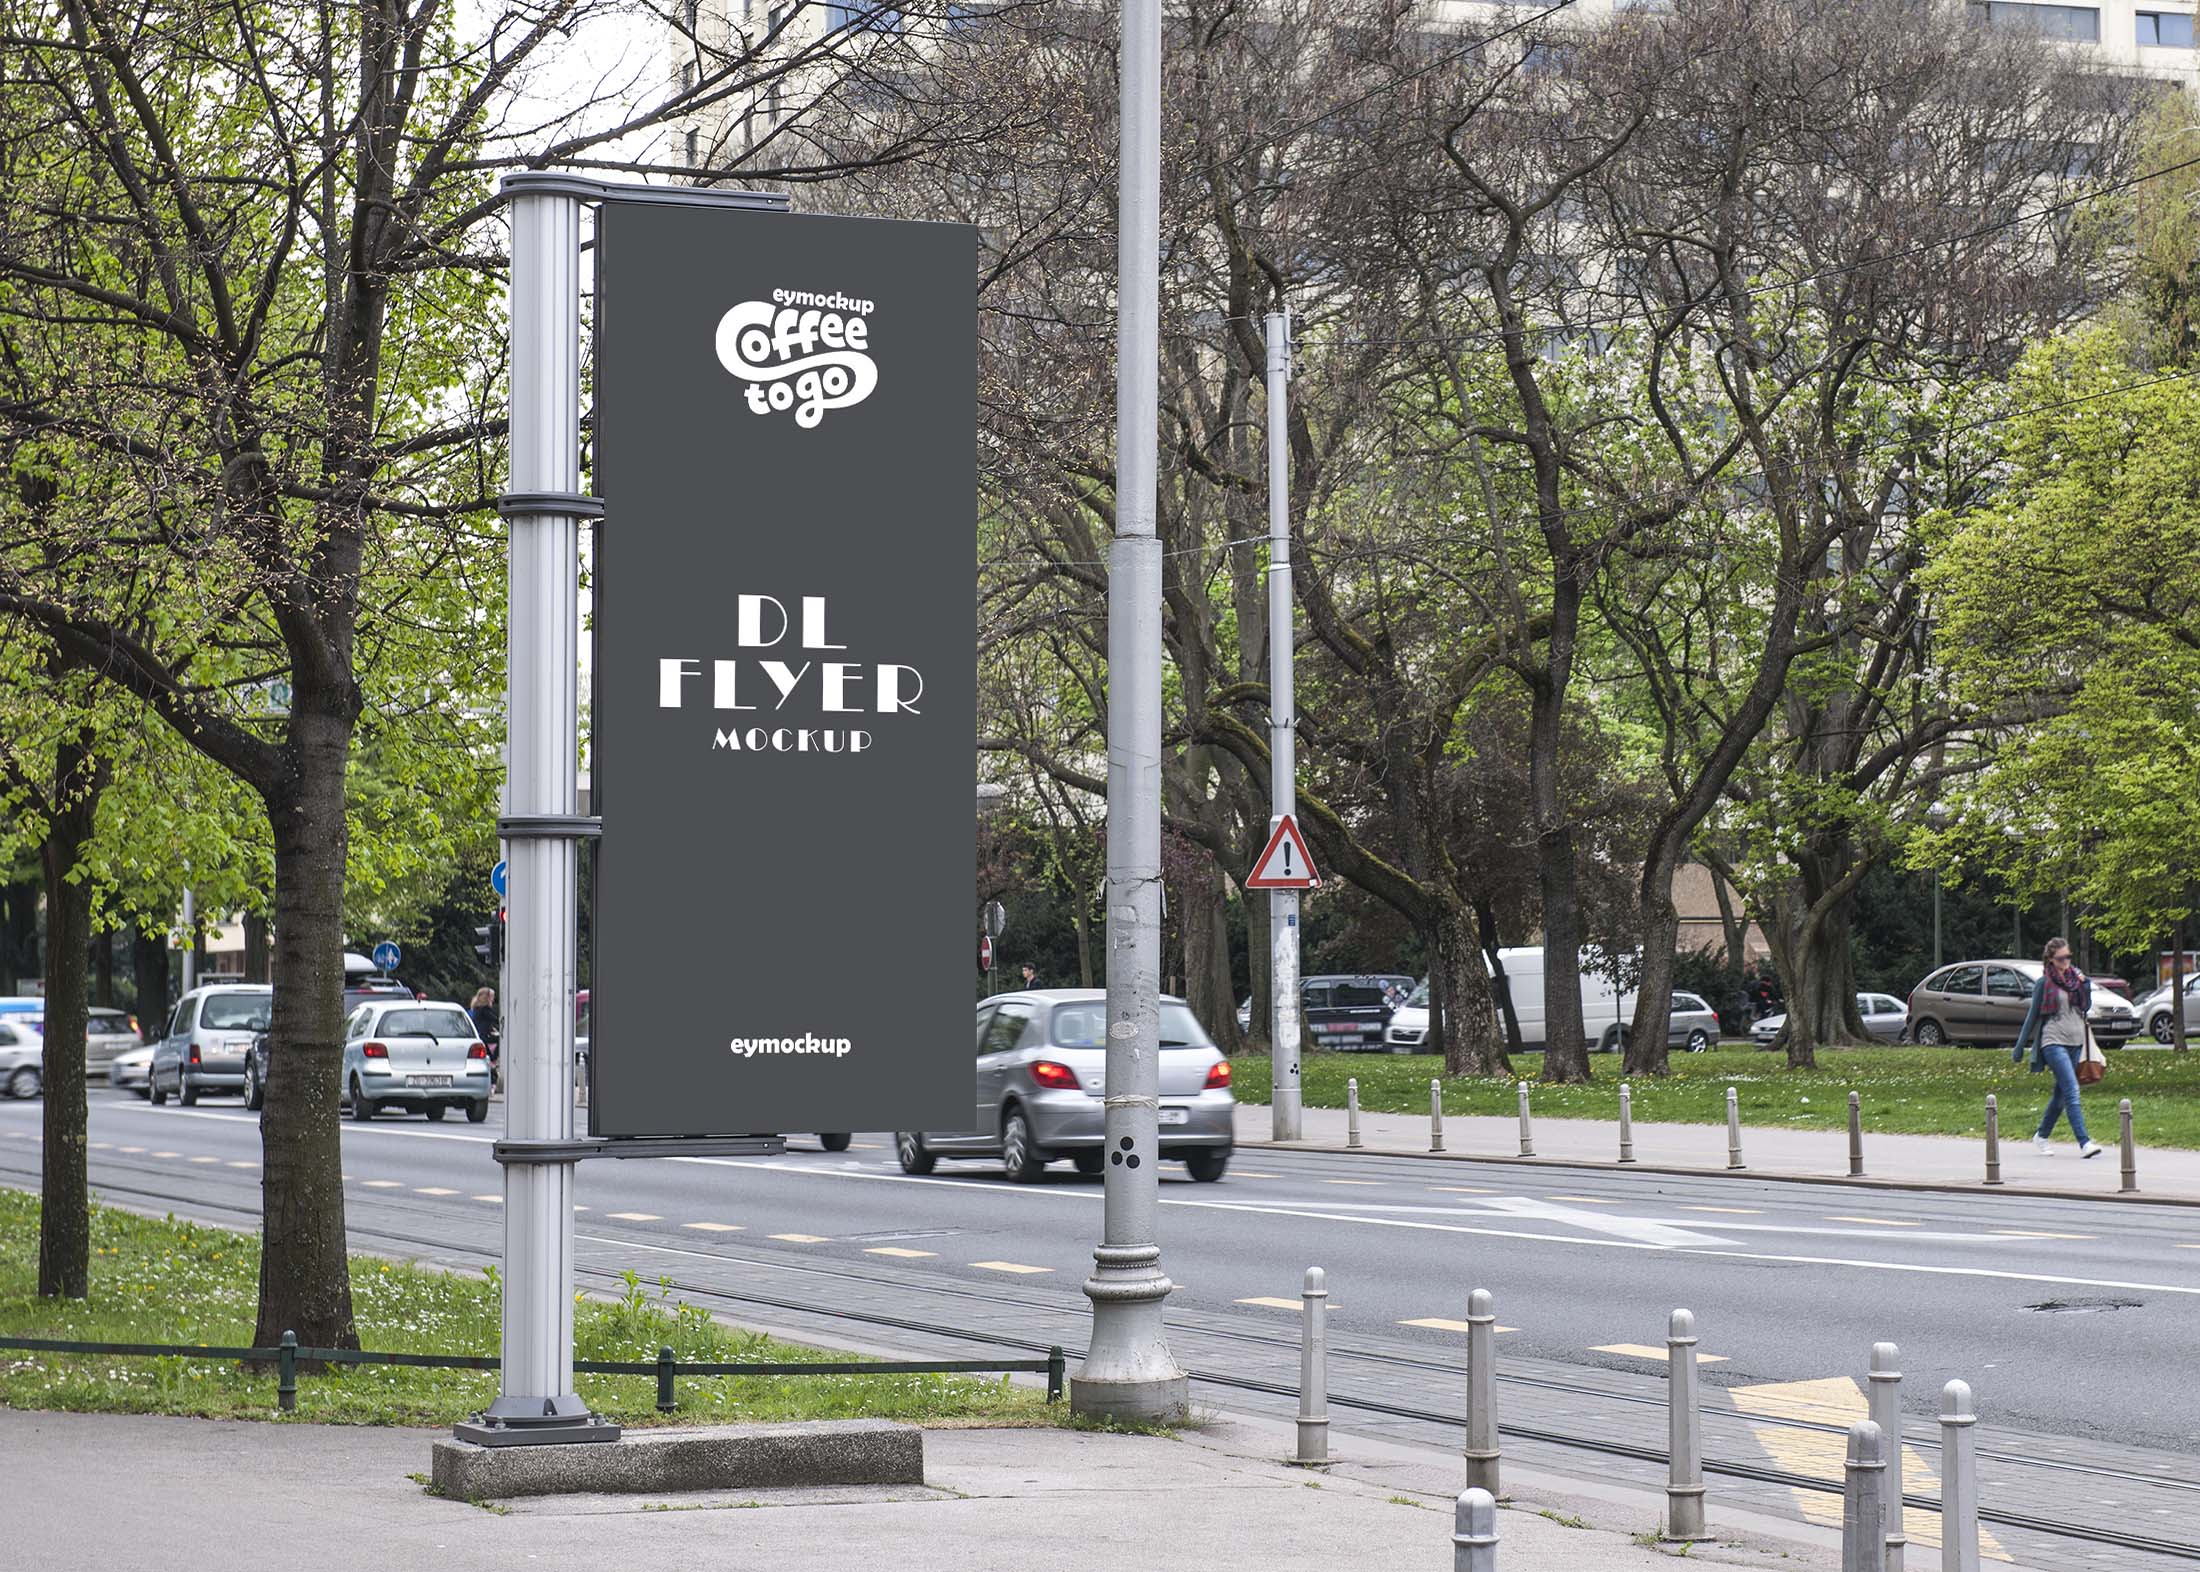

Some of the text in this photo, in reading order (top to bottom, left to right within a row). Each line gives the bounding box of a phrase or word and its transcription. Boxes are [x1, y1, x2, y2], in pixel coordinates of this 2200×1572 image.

[772, 288, 875, 317] eymockup
[716, 301, 870, 381] Coffee
[744, 367, 874, 429] to go
[738, 595, 848, 650] DL
[660, 659, 925, 715] FLYER
[713, 728, 873, 753] MOCKUP
[731, 1032, 851, 1058] eymockup
